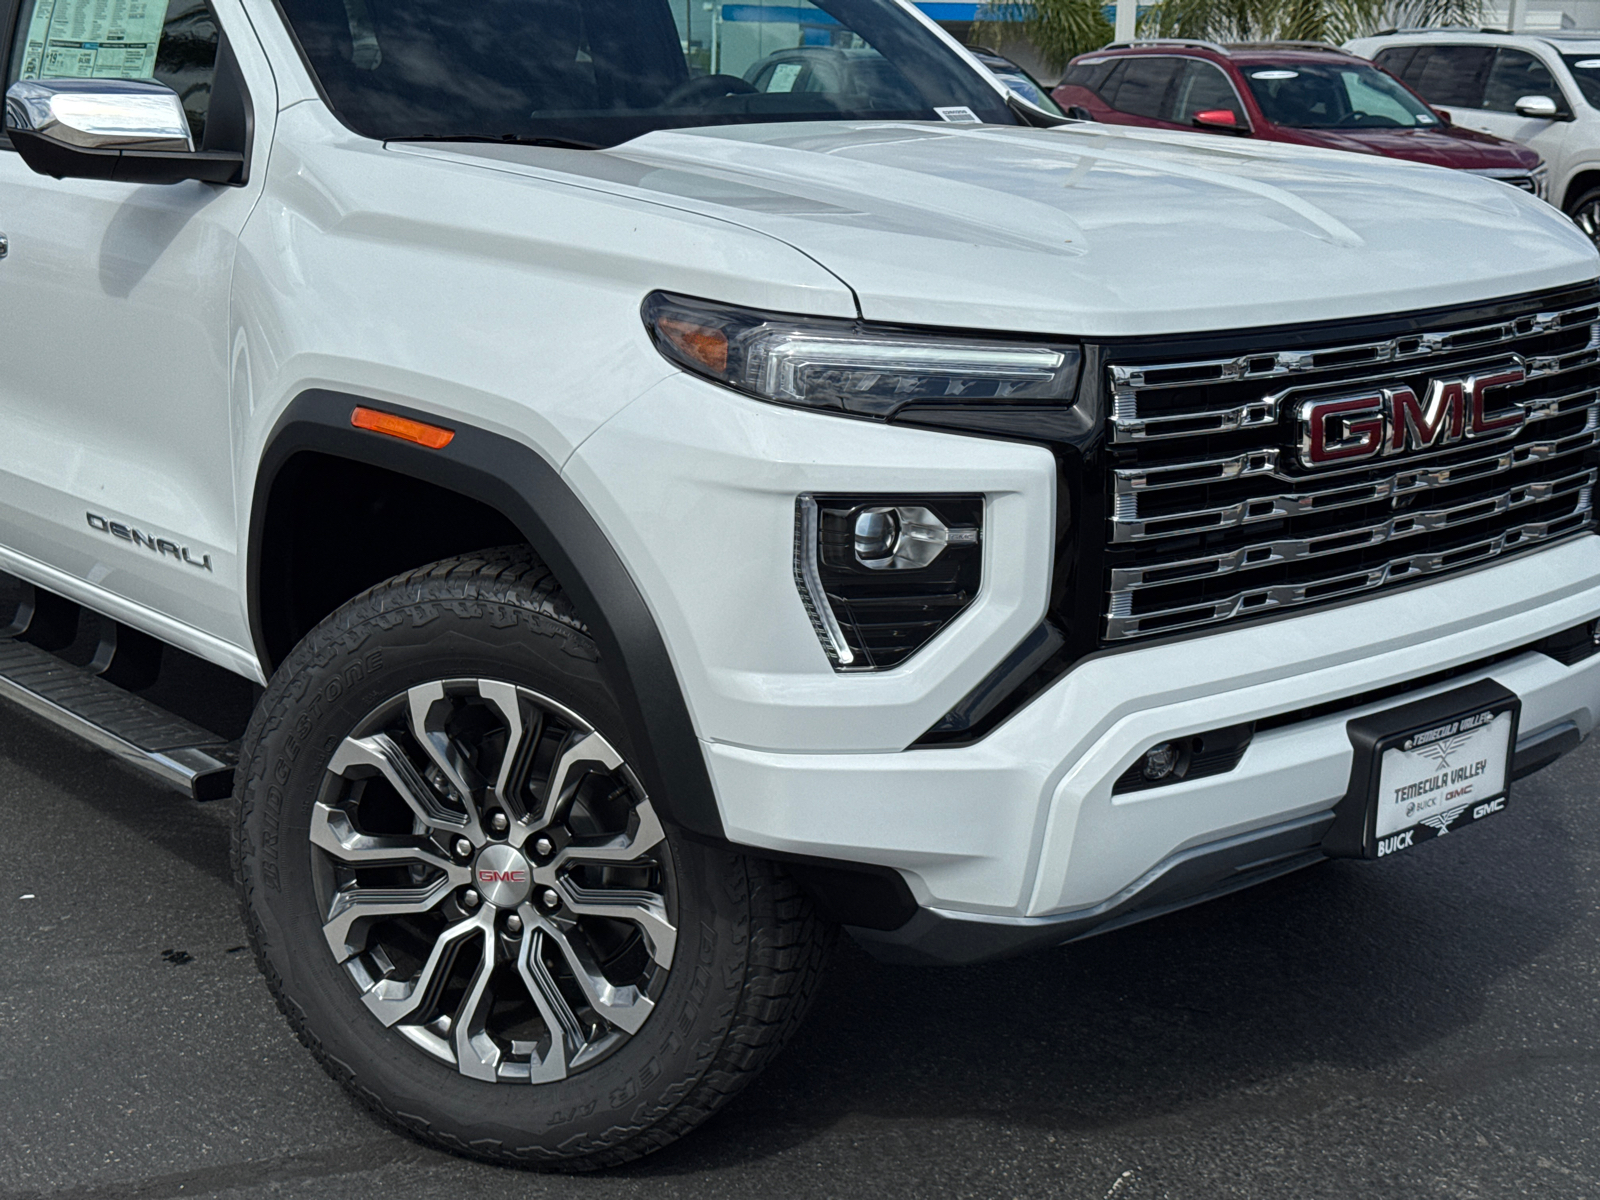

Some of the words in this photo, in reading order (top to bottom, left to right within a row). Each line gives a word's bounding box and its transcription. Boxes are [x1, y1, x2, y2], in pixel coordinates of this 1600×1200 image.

[1299, 368, 1526, 470] GMC
[86, 511, 213, 573] DENALI
[1412, 722, 1459, 746] TEMECULA
[263, 649, 385, 893] BRIDGESTONE
[1394, 772, 1448, 804] TEMECULA
[1450, 759, 1487, 785] VALLEY
[1416, 797, 1437, 812] BUICK
[1445, 784, 1473, 801] GMC
[1473, 797, 1506, 819] GMC
[1377, 829, 1414, 857] BUICK
[479, 870, 526, 882] GMC
